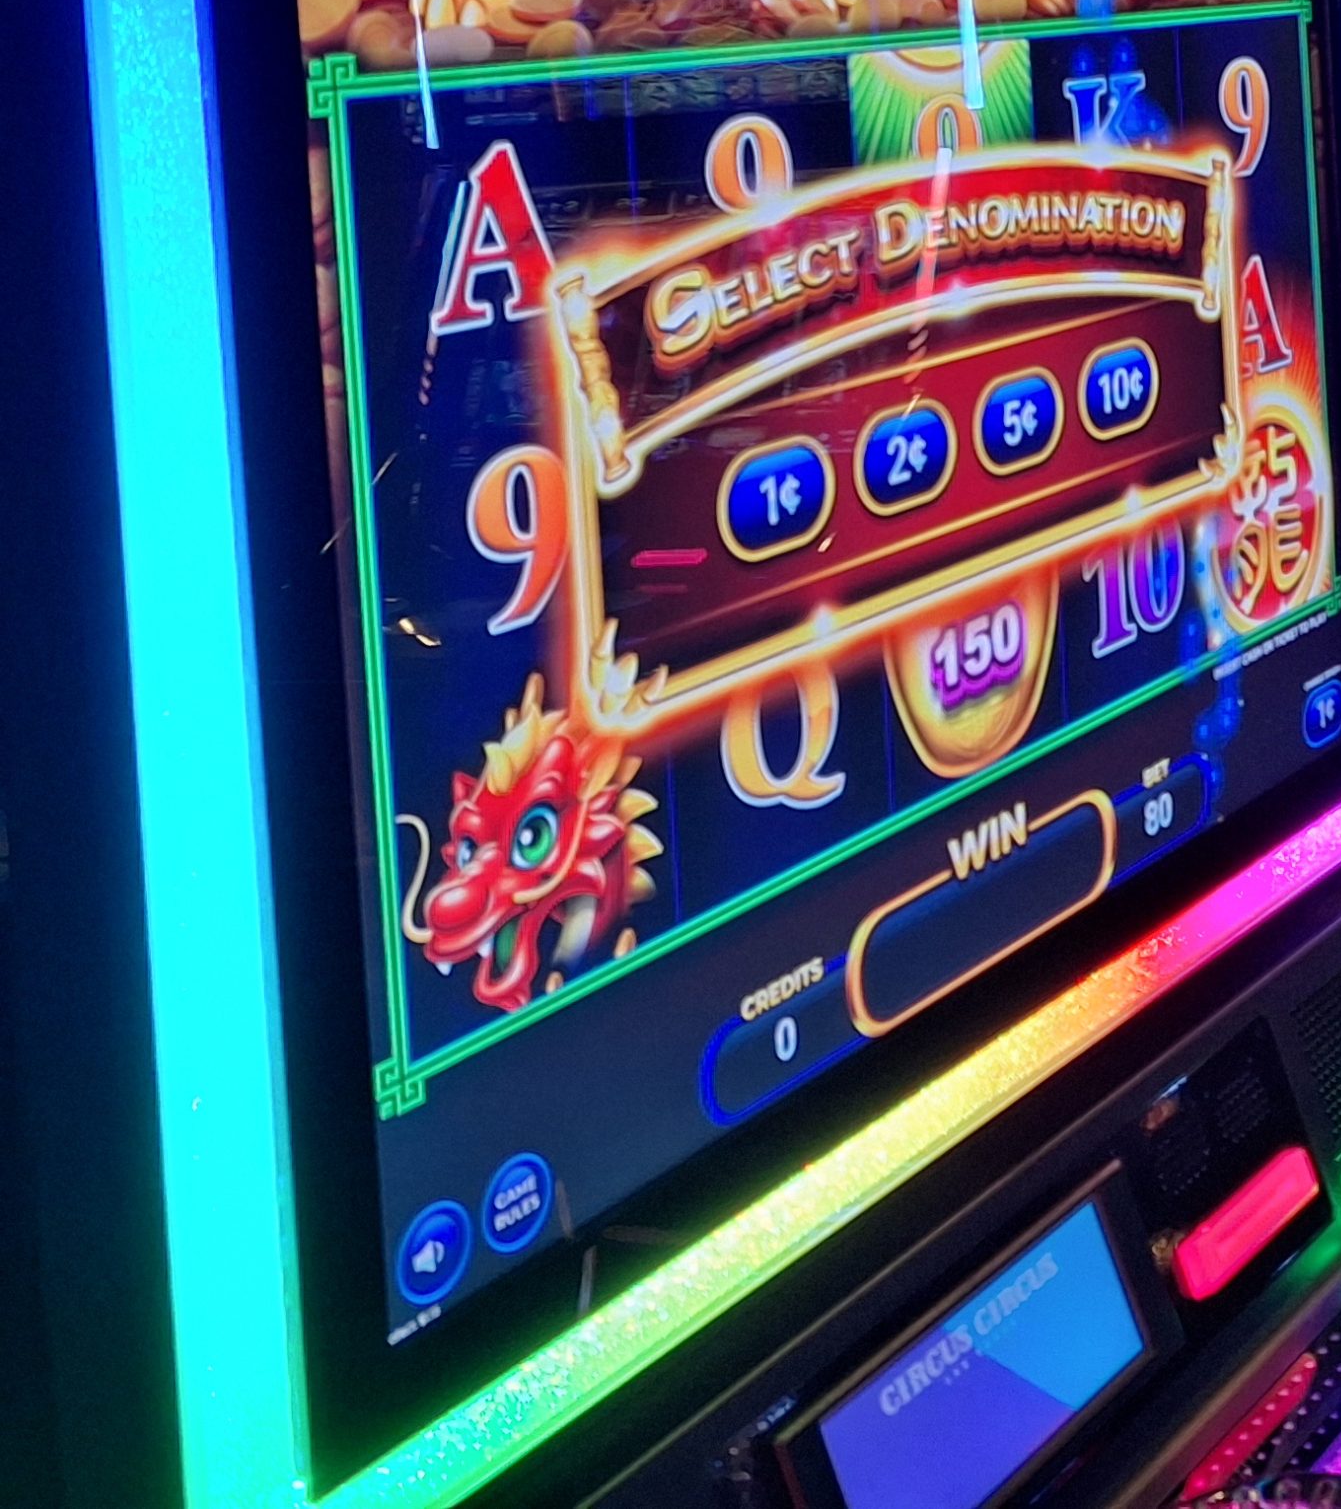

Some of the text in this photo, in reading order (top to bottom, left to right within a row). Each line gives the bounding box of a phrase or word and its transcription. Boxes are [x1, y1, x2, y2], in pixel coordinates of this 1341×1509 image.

[1218, 57, 1271, 178] 9
[431, 139, 558, 336] A
[647, 192, 1187, 361] SELECT DENOMINATION
[1002, 395, 1039, 447] 5¢
[1097, 364, 1145, 413] 10¢
[757, 470, 804, 527] 1¢
[885, 433, 929, 487] 2¢
[466, 444, 569, 636] 9
[1082, 515, 1186, 659] 10
[930, 602, 1026, 701] 150
[719, 657, 845, 809] Q
[1142, 757, 1170, 789] BET
[948, 802, 1028, 881] WIN
[1143, 791, 1174, 837] 80
[740, 956, 824, 1023] CREDITS
[774, 1015, 797, 1062] 0
[879, 1323, 974, 1417] CIRCUS
